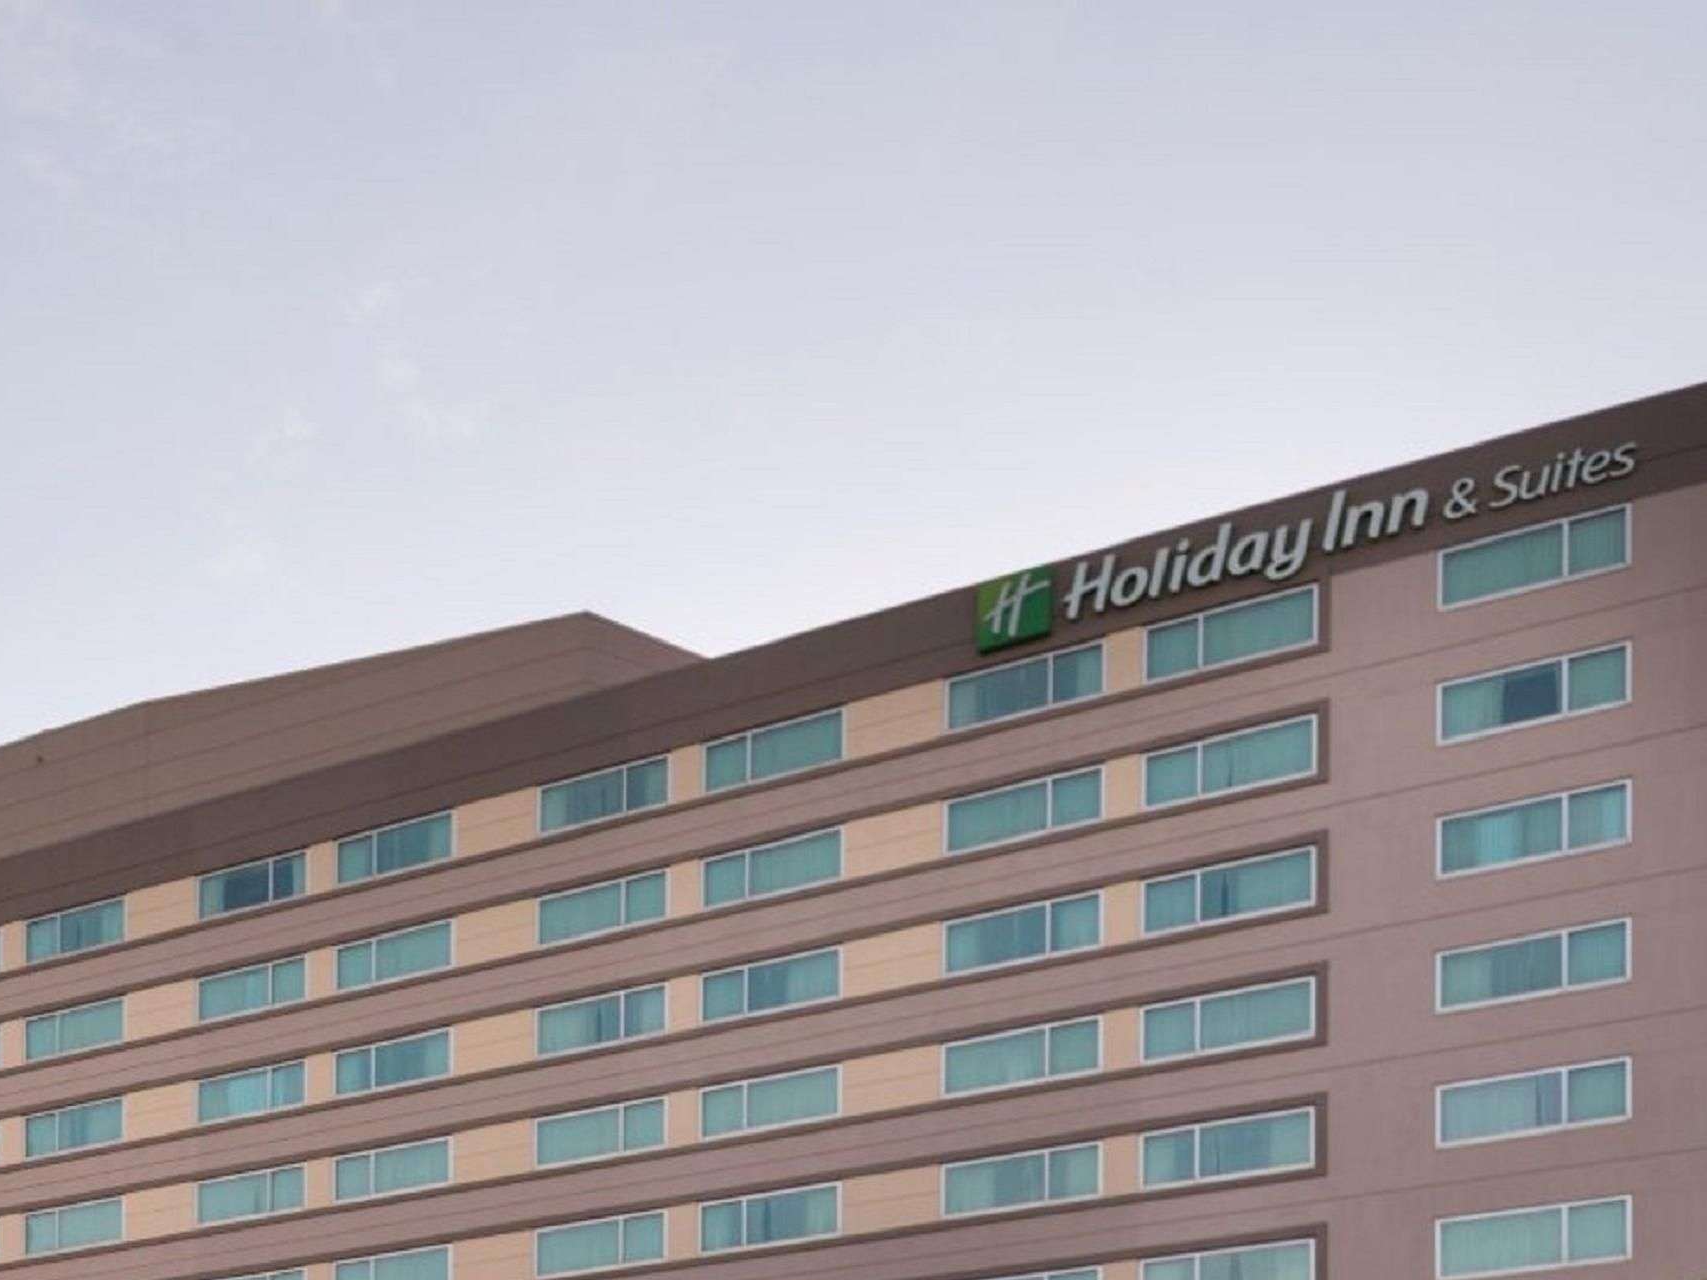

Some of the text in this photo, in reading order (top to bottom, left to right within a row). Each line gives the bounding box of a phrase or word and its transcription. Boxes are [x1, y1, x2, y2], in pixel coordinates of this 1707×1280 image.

[1063, 441, 1637, 620] Holiday Inn & Suites
